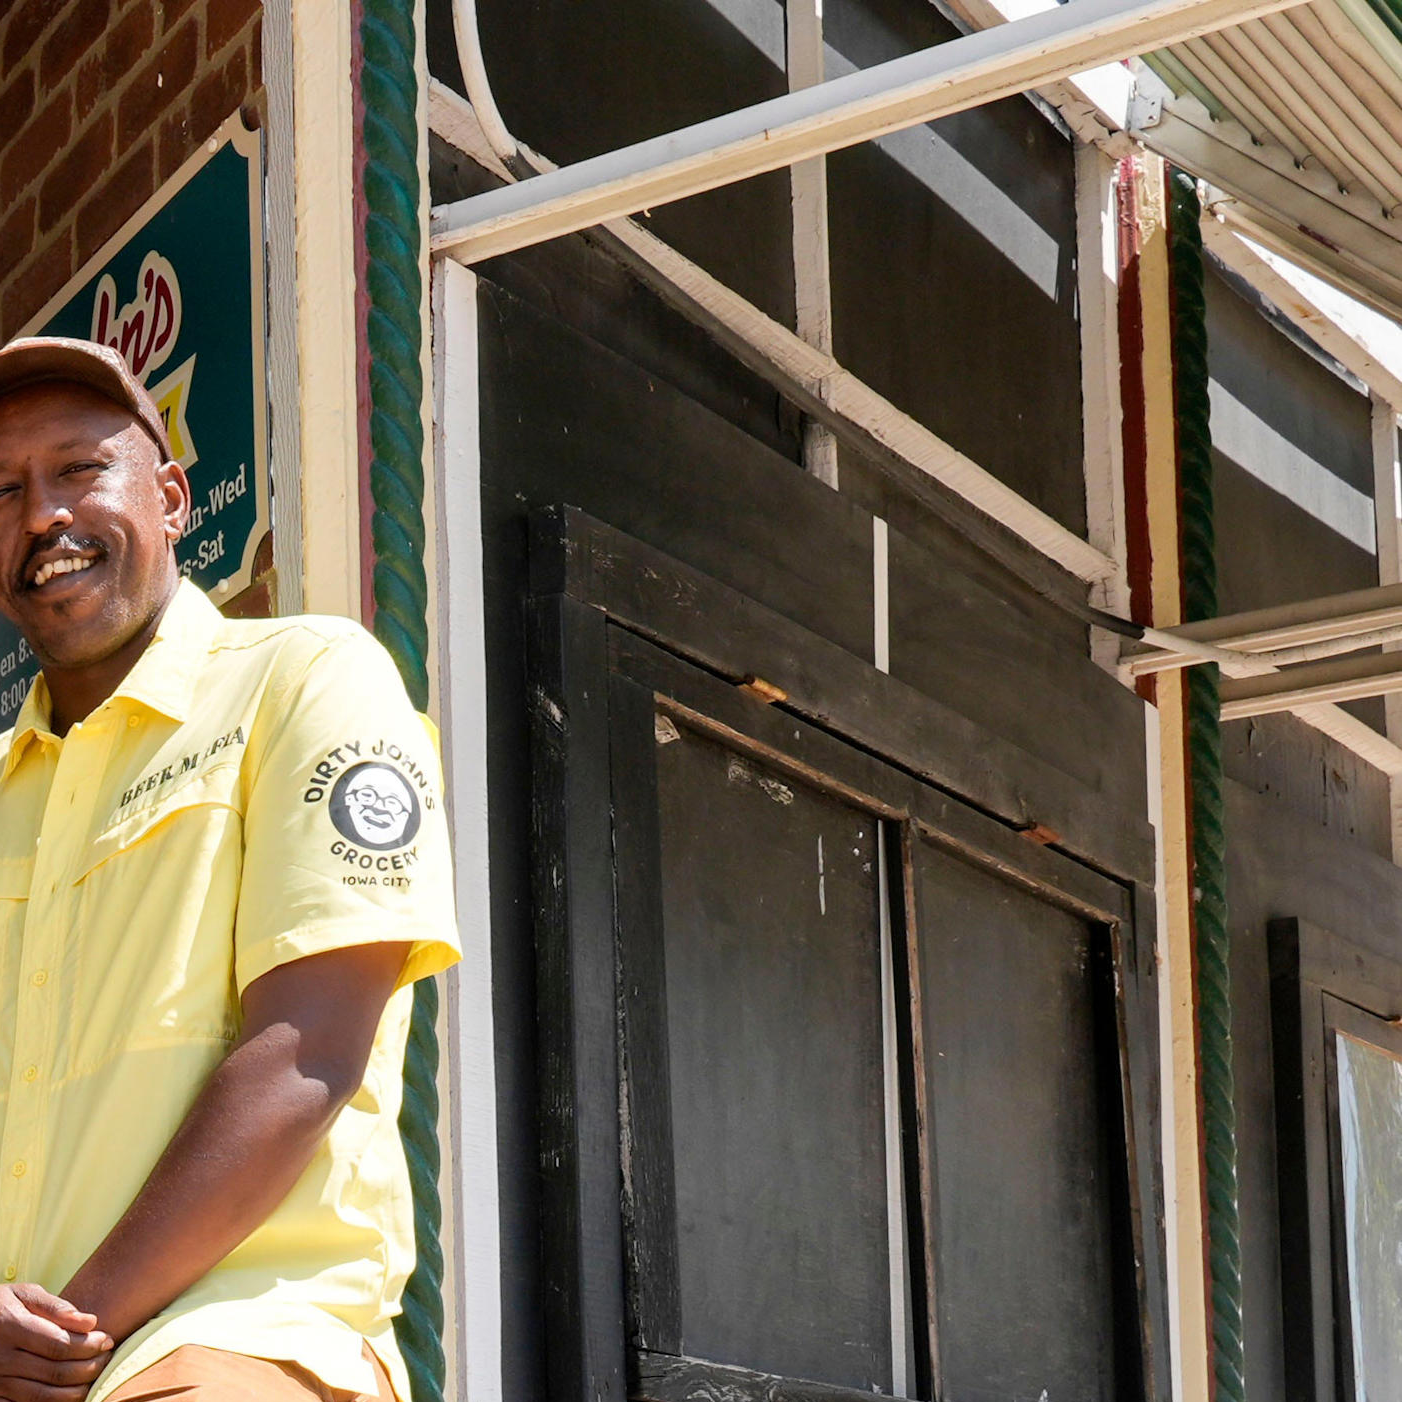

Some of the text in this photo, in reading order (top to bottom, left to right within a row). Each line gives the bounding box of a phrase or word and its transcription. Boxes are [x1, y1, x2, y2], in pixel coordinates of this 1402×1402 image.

[97, 267, 174, 376] hn's
[173, 462, 247, 545] un-Wed
[0, 677, 26, 716] 8:00
[303, 740, 362, 804] DIRTY
[330, 840, 420, 872] GROCERY
[342, 876, 412, 887] IOWA CITY
